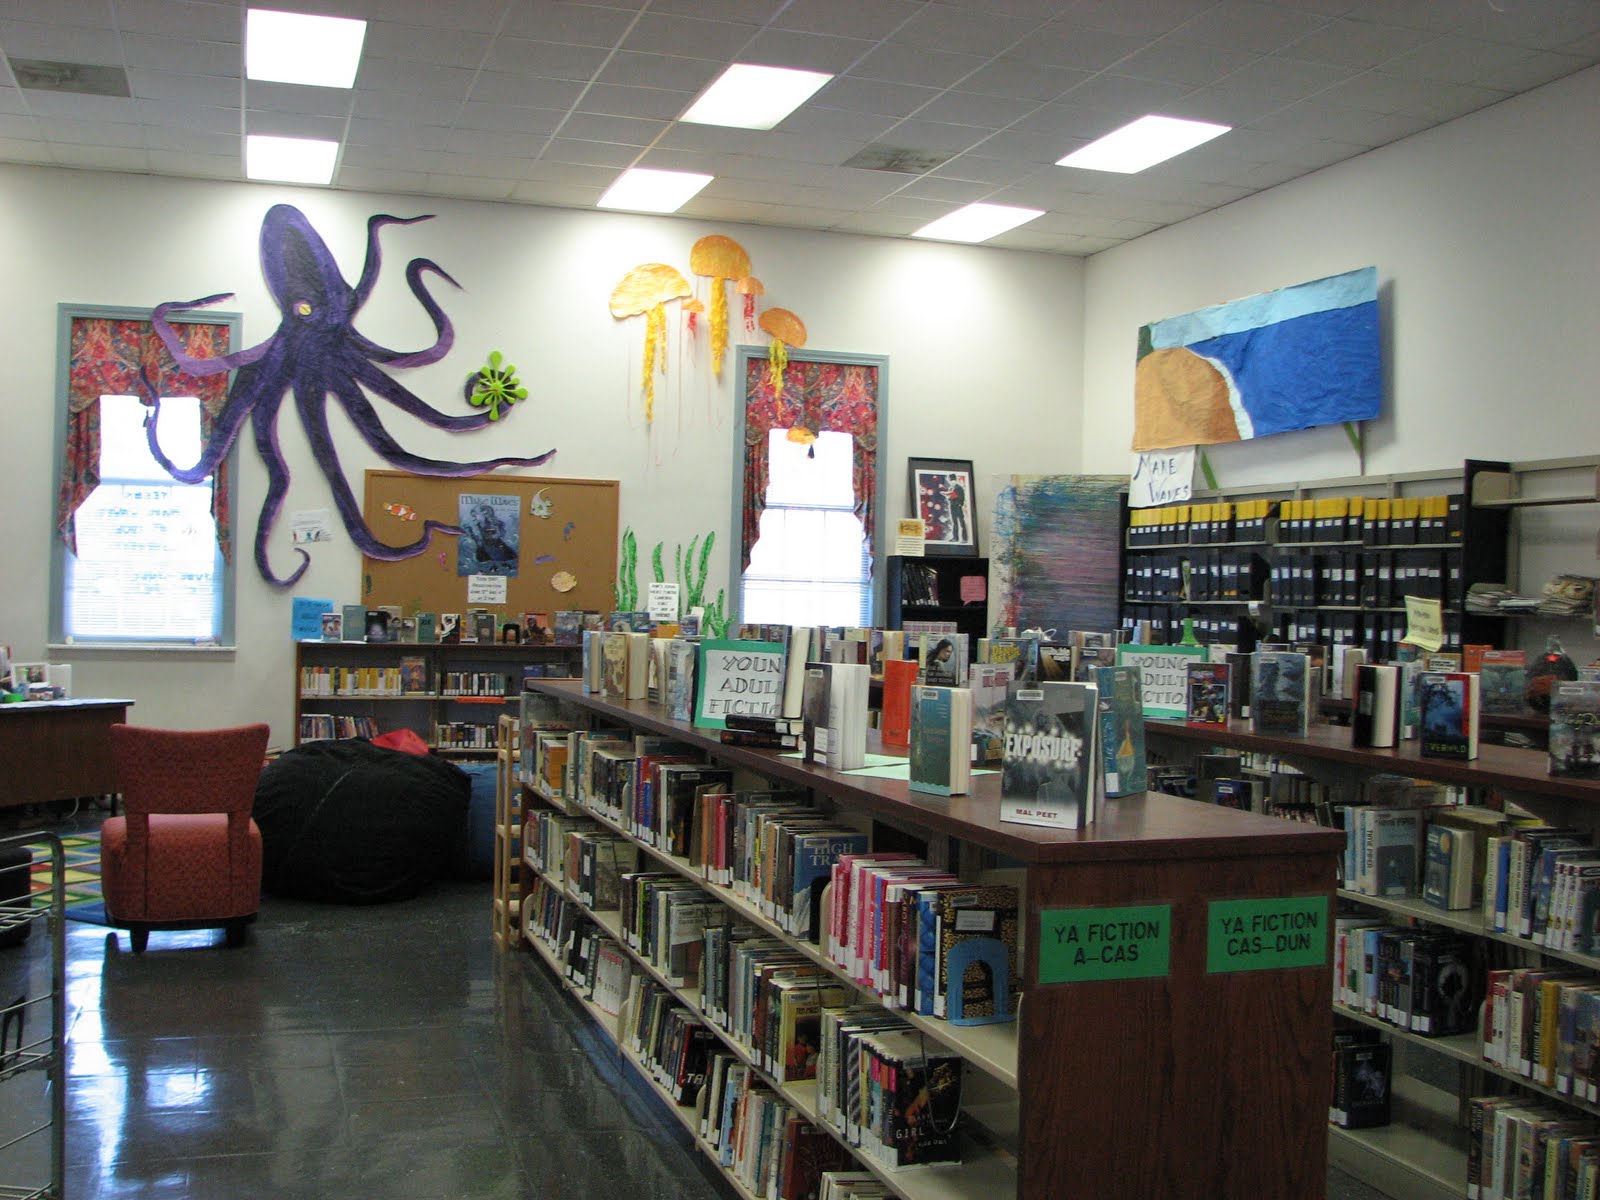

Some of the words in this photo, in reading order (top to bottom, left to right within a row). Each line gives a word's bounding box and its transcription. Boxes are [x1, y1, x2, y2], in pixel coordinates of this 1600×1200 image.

[1133, 453, 1176, 480] MAKE
[1148, 478, 1188, 502] WAVES
[722, 655, 782, 673] YOUN
[718, 677, 782, 694] ADUL
[1144, 673, 1187, 687] DULT
[1143, 690, 1187, 704] CTIO
[709, 698, 782, 716] FICTI
[1005, 733, 1082, 761] EXPOSURE
[1016, 808, 1033, 817] MAL
[1036, 811, 1058, 819] PEET
[1055, 924, 1080, 943] YA
[1088, 921, 1161, 943] FICTION
[1221, 916, 1245, 935] YA
[1252, 911, 1319, 932] FICTION
[895, 1127, 925, 1139] GIRL
